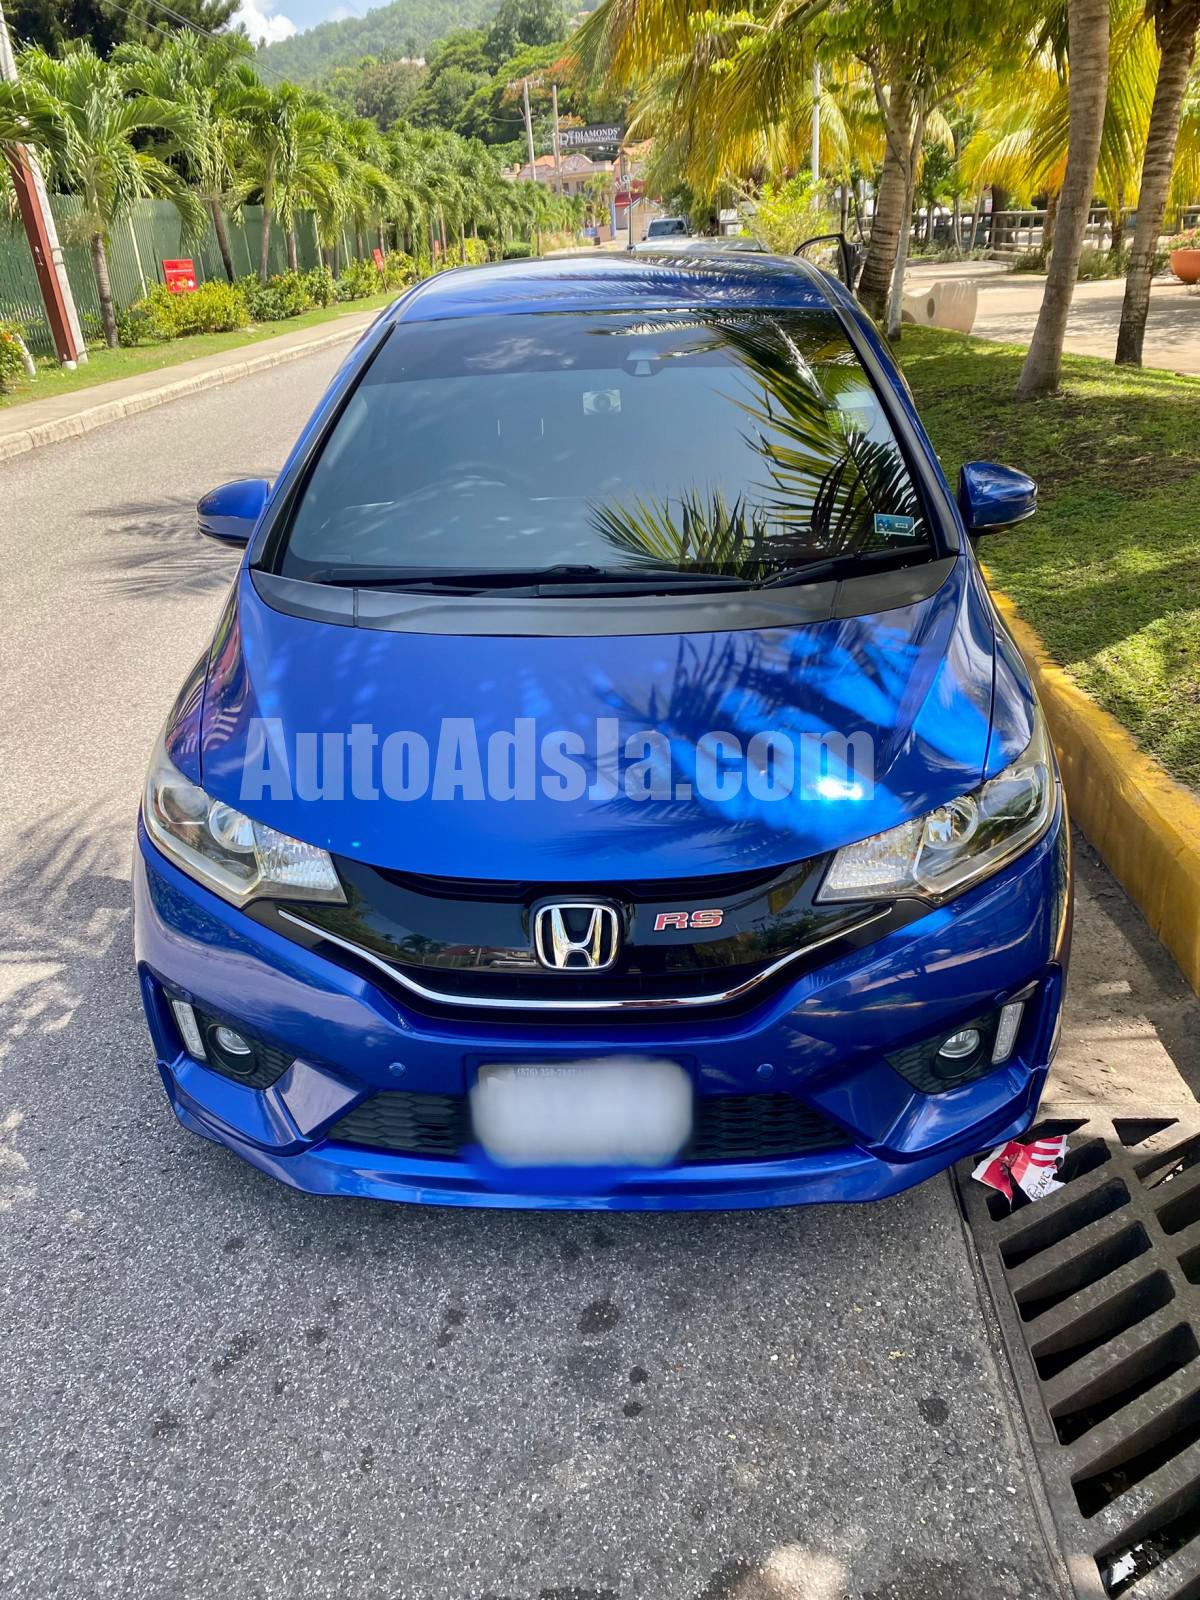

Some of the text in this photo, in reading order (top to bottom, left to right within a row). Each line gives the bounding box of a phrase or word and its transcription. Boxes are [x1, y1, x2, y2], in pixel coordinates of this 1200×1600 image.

[575, 128, 618, 138] DIAMONDS
[653, 909, 724, 931] RS
[1038, 1171, 1051, 1190] KFC
